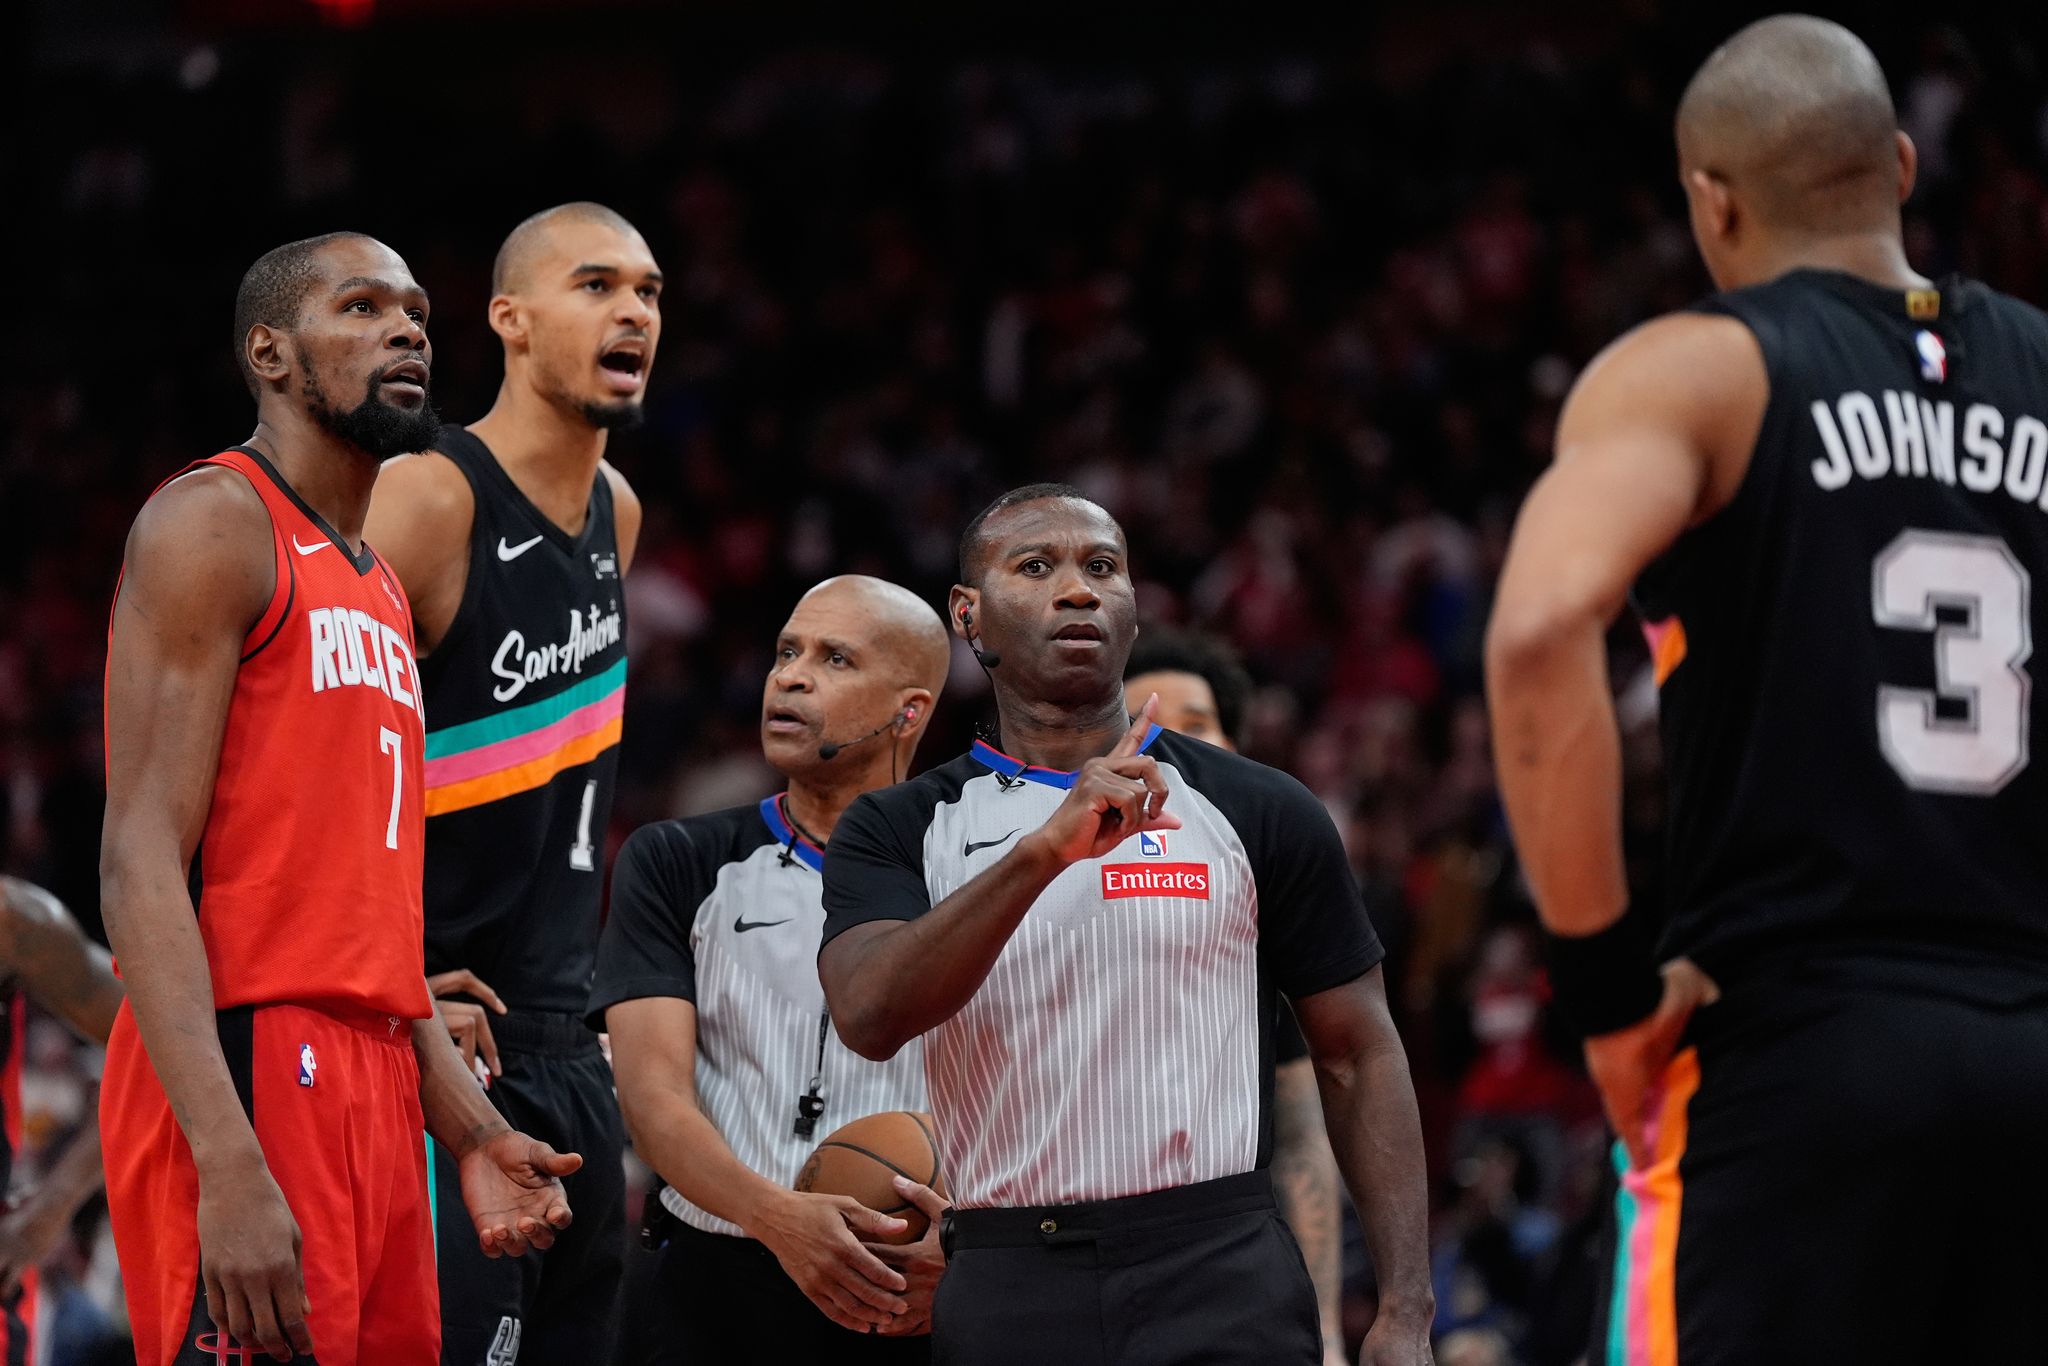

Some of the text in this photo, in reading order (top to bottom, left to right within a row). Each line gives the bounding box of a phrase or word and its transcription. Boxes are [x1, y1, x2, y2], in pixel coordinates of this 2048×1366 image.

[1810, 388, 2048, 514] JOHNSO
[308, 606, 425, 728] ROCKET
[491, 630, 557, 702] San
[1867, 526, 2033, 798] 3
[379, 724, 402, 850] 7
[568, 779, 598, 872] 1
[1104, 869, 1207, 891] Emirates
[1144, 844, 1158, 854] NBA
